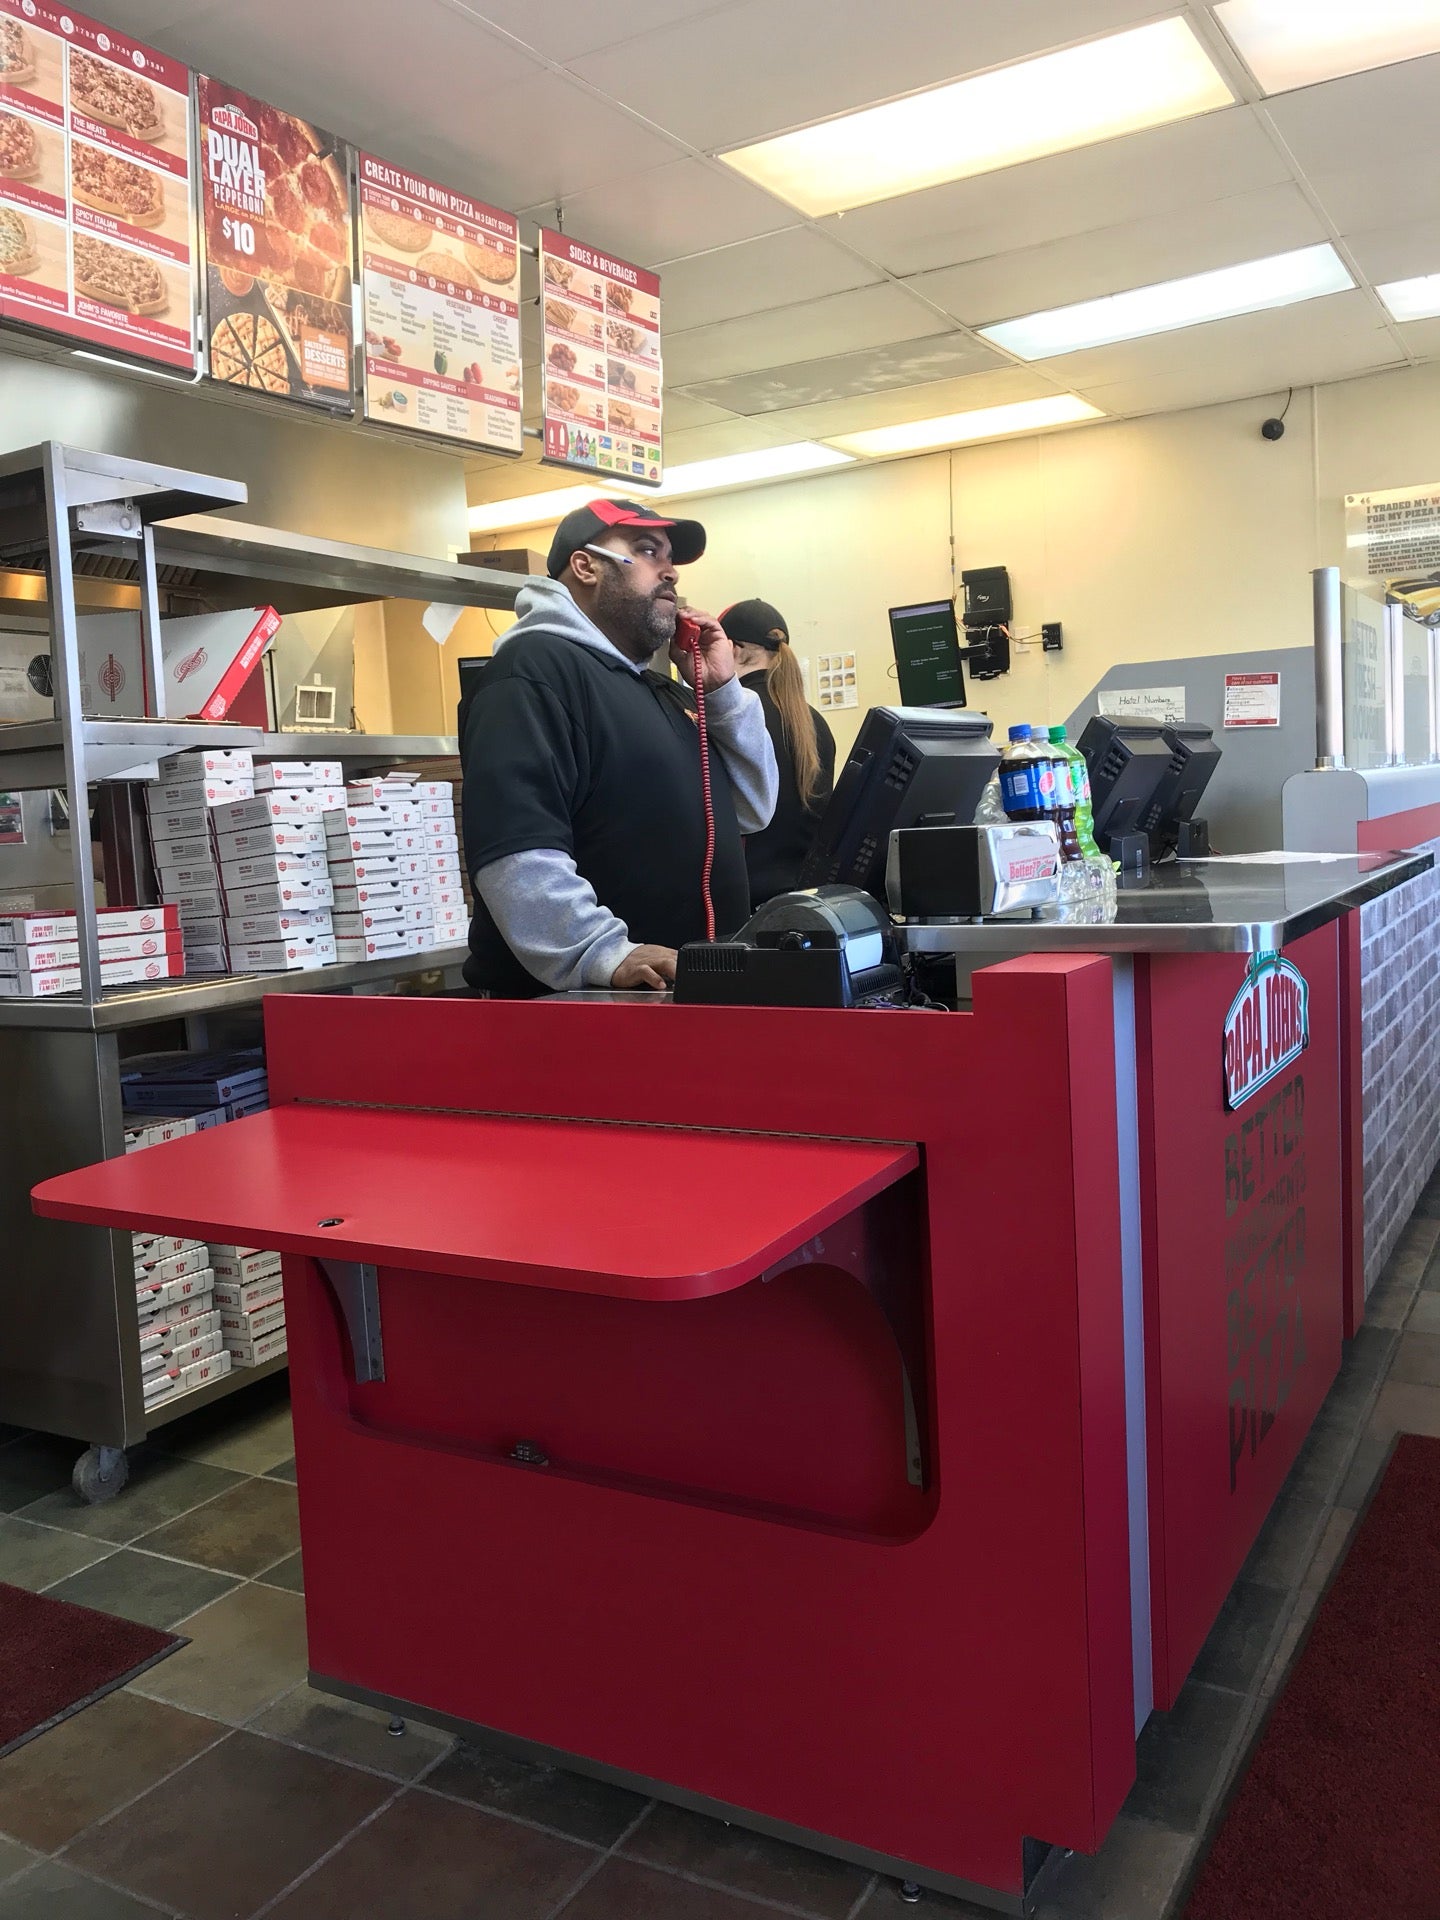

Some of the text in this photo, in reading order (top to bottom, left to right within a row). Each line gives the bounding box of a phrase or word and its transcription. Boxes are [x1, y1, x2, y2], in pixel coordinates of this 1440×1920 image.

[73, 116, 106, 136] THE MEATS
[214, 110, 232, 128] PAPA
[208, 128, 266, 178] DUAL
[209, 156, 266, 200] LAYER
[214, 183, 264, 216] PEPPERONI
[363, 188, 368, 200] 1
[365, 159, 402, 188] CREATE
[403, 175, 428, 199] YOUR
[428, 186, 448, 208] OWN
[450, 195, 474, 218] PIZZA
[481, 214, 484, 223] 3
[485, 216, 498, 228] EASY
[498, 220, 513, 235] STEPS
[215, 202, 240, 216] LARGE
[76, 208, 118, 230] SPICY ITALIAN
[222, 216, 255, 256] $10
[366, 255, 372, 268] 2
[569, 244, 637, 284] SIDES & BEVERAGES
[78, 300, 128, 323] JOHN'S FAVORITE
[304, 348, 346, 369] DESSERTS
[369, 360, 375, 372] 3
[1367, 498, 1428, 514] I TRADED MY
[1367, 507, 1434, 524] FOR MY PIZZA
[1226, 984, 1263, 1100] PAPA
[162, 1129, 174, 1140] 10"
[1224, 1074, 1304, 1220] BETTER
[173, 1239, 184, 1251] 10"
[176, 1262, 187, 1273] 10"
[215, 1267, 232, 1275] SIDES
[182, 1283, 193, 1294] 10"
[216, 1295, 232, 1303] SIDES
[180, 1305, 191, 1316] 10"
[189, 1326, 200, 1337] 10"
[223, 1320, 239, 1328] SIDES
[191, 1347, 202, 1358] 10"
[200, 1367, 210, 1379] 10"
